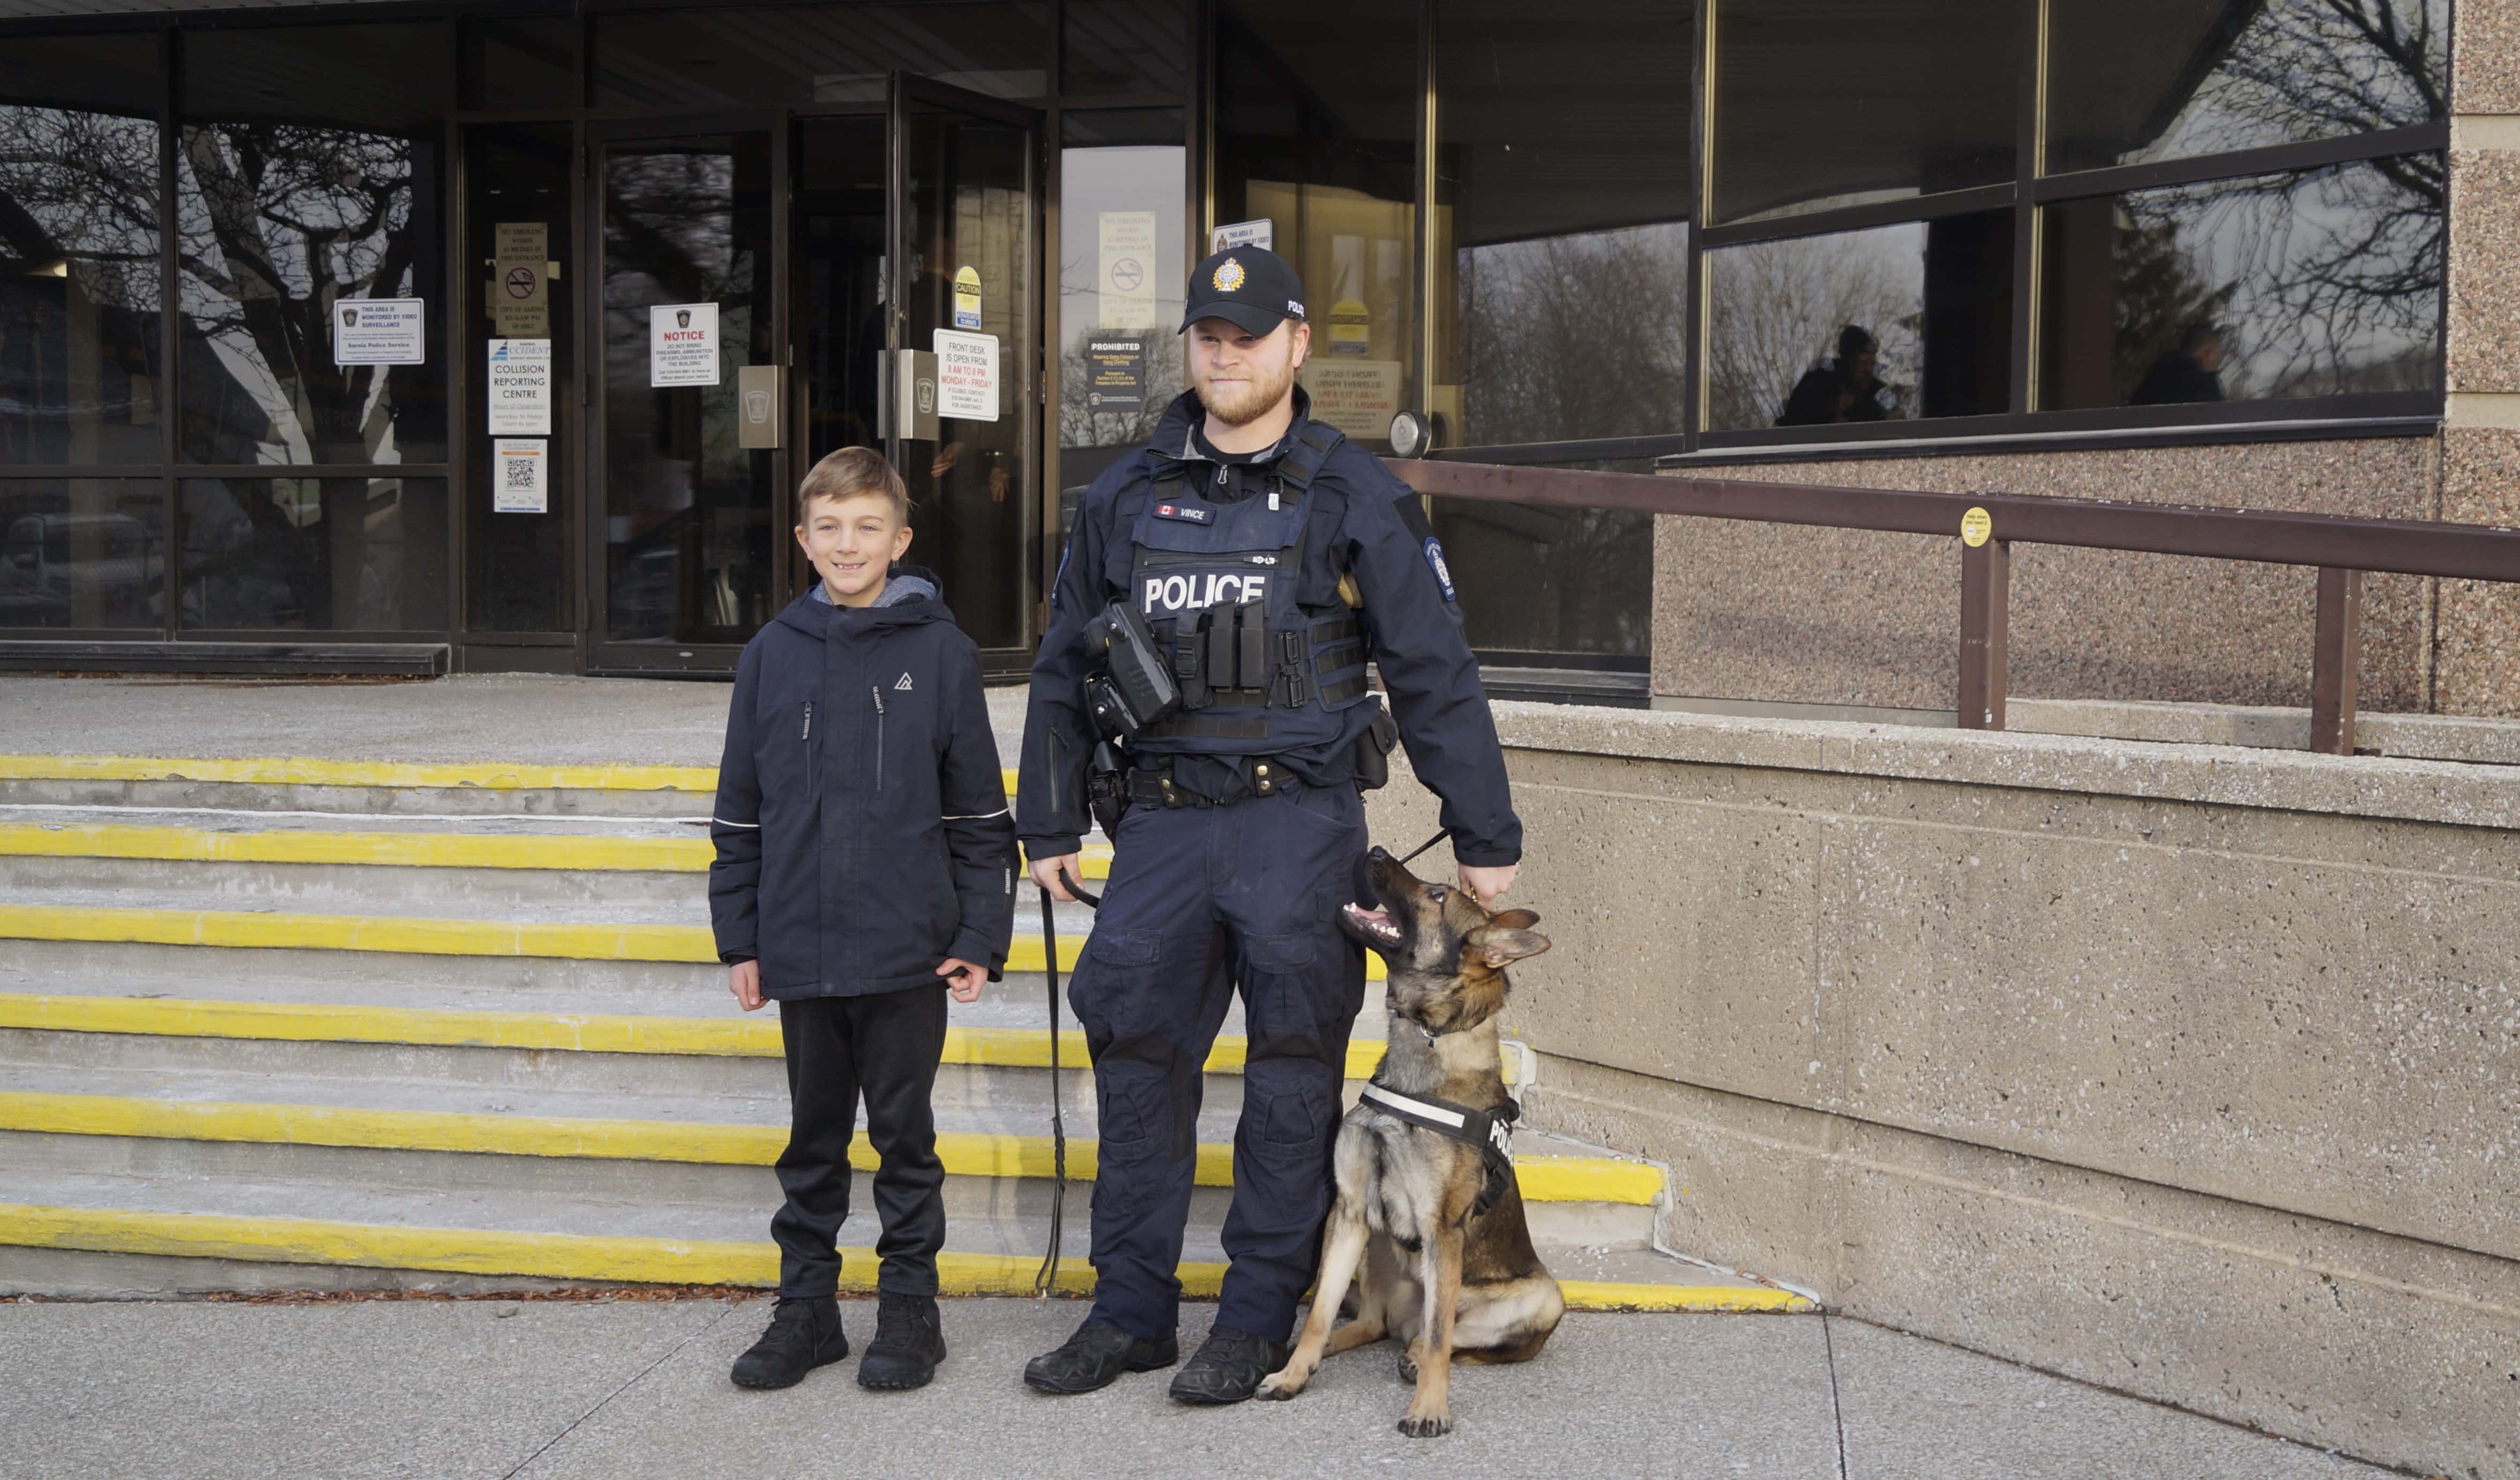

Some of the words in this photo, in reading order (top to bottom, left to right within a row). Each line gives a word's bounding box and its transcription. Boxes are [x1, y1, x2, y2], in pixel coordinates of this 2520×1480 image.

[957, 283, 979, 295] CAUTION
[664, 331, 705, 341] NOTICE
[948, 342, 968, 352] FRONT
[970, 345, 985, 354] DESK
[946, 353, 952, 361] IS
[953, 354, 970, 364] OPEN
[971, 356, 987, 365] FROM
[495, 365, 544, 373] COLLISION
[948, 364, 952, 373] 8
[953, 365, 962, 373] AM
[964, 367, 971, 375] TO
[973, 368, 976, 376] 8
[977, 368, 986, 377] PM
[494, 377, 545, 386] REPORTING
[941, 375, 966, 386] MONDAY
[971, 379, 992, 388] FRIDAY
[503, 390, 537, 398] CENTRE
[1181, 509, 1205, 520] VINCE
[1146, 574, 1265, 614] POLICE
[1490, 1119, 1514, 1167] POLIC
